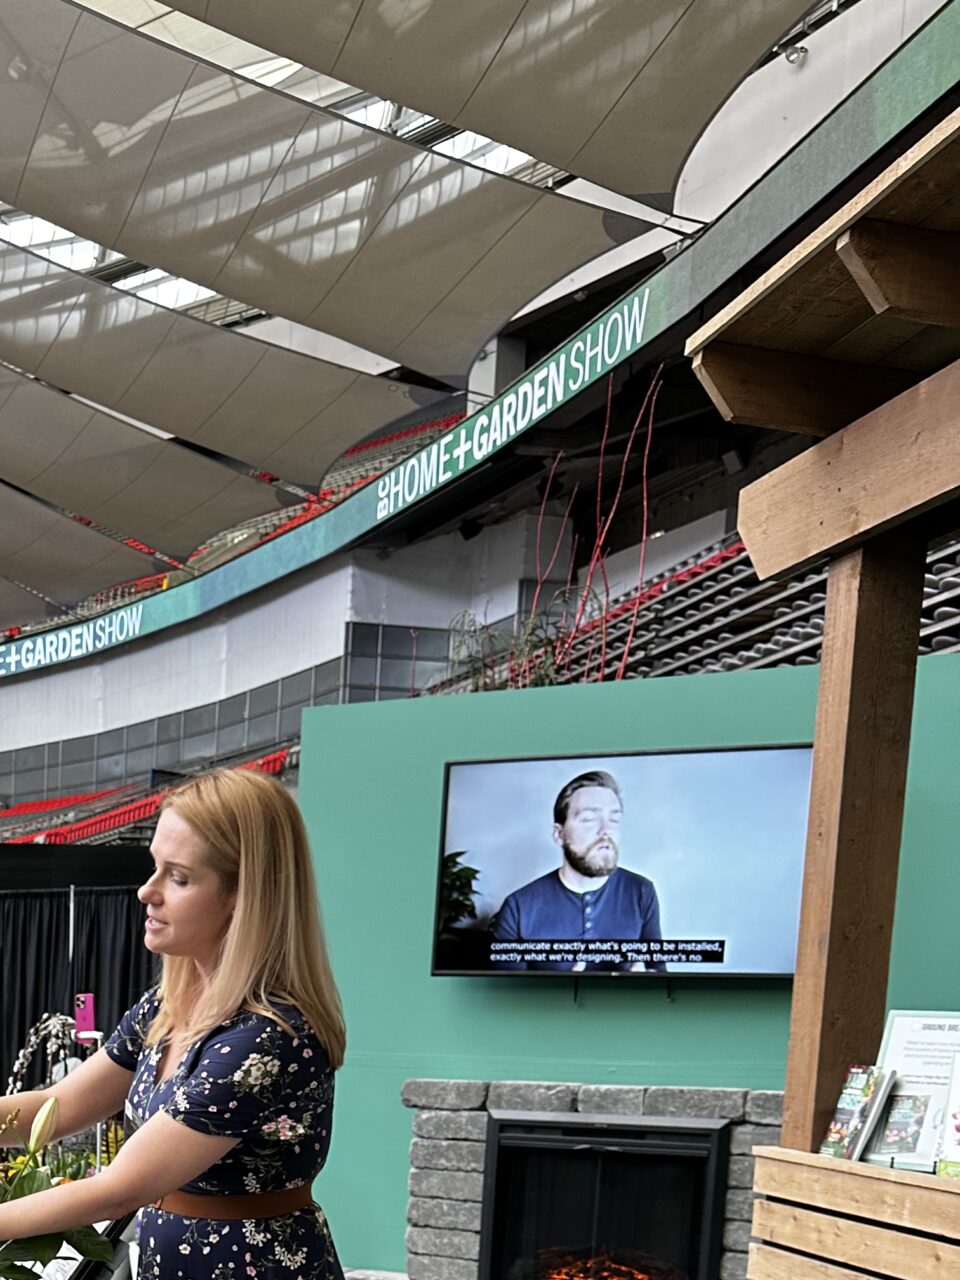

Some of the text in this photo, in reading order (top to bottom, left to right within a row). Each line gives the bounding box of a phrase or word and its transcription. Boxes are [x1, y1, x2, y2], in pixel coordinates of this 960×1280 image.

[570, 288, 650, 392] SHOW
[96, 605, 143, 648] SHOW
[490, 942, 722, 952] communicate exactly what's going to be installed,
[490, 953, 522, 962] exactly
[524, 953, 546, 961] what
[548, 953, 574, 961] we're
[576, 953, 624, 963] designing.
[627, 953, 650, 961] Then
[653, 953, 686, 961] there's
